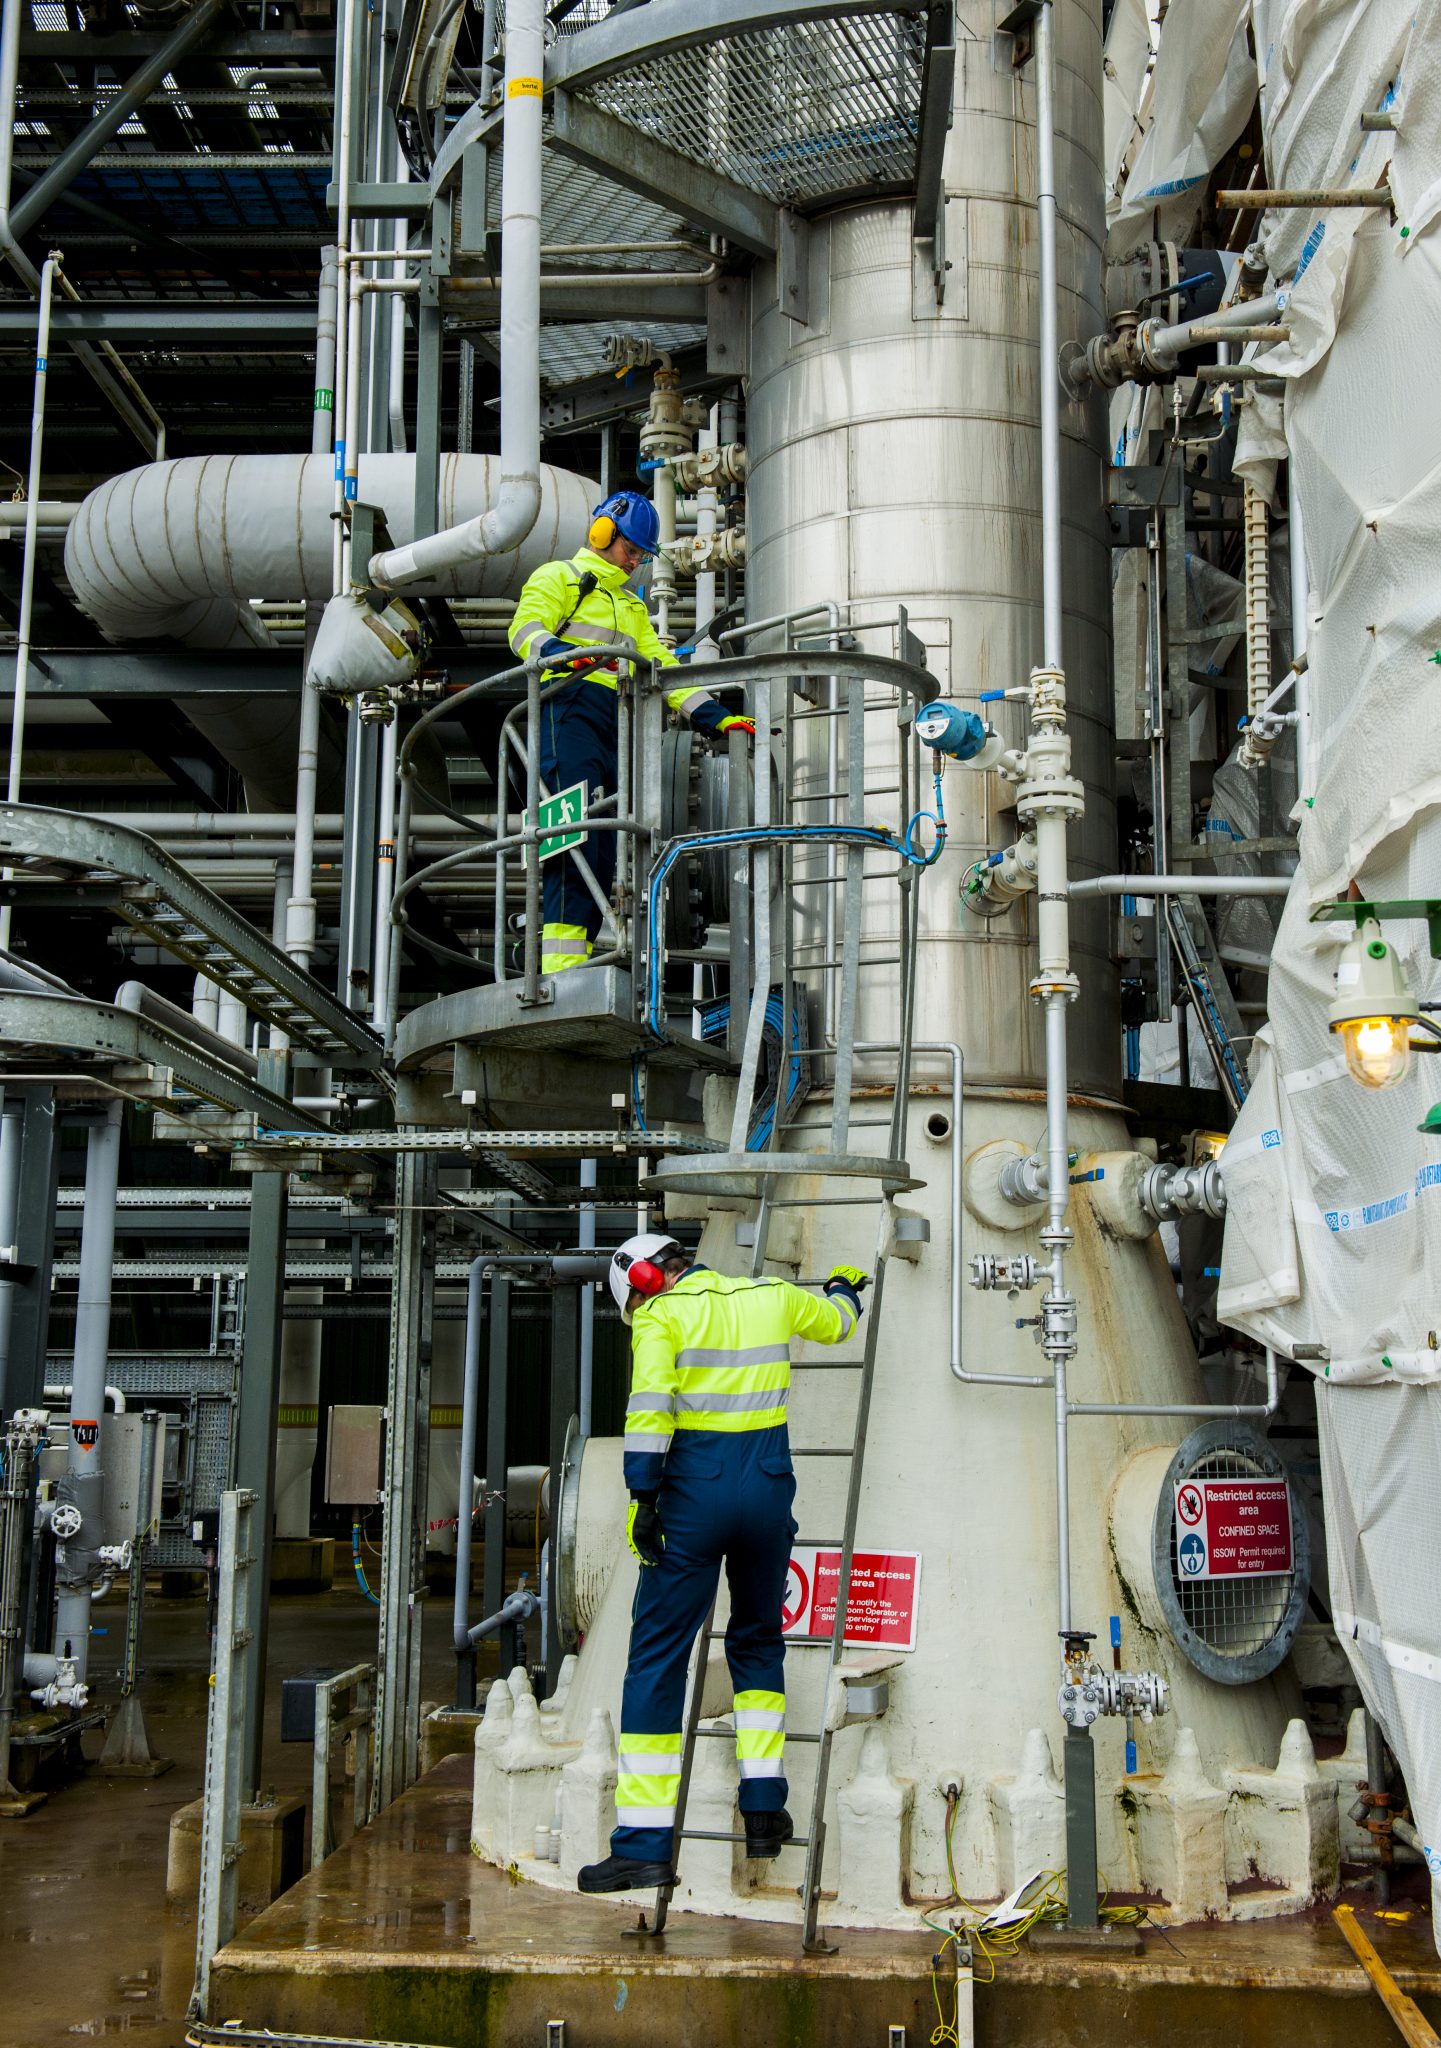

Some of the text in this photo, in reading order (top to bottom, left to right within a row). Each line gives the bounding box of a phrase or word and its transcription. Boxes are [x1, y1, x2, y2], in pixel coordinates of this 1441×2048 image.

[1206, 1489, 1286, 1502] Restricted access
[1239, 1506, 1259, 1516] area
[1218, 1524, 1280, 1537] CONFINED SPACE
[1213, 1545, 1286, 1558] ISSOW Permit required
[1237, 1559, 1265, 1570] for entry
[818, 1567, 911, 1580] Restted access
[851, 1580, 875, 1588] area
[830, 1597, 892, 1608] Plse notify the
[814, 1605, 837, 1613] Contro
[865, 1608, 898, 1617] Operator
[821, 1613, 900, 1626] Shif upervisor prior
[855, 1623, 875, 1633] entry
